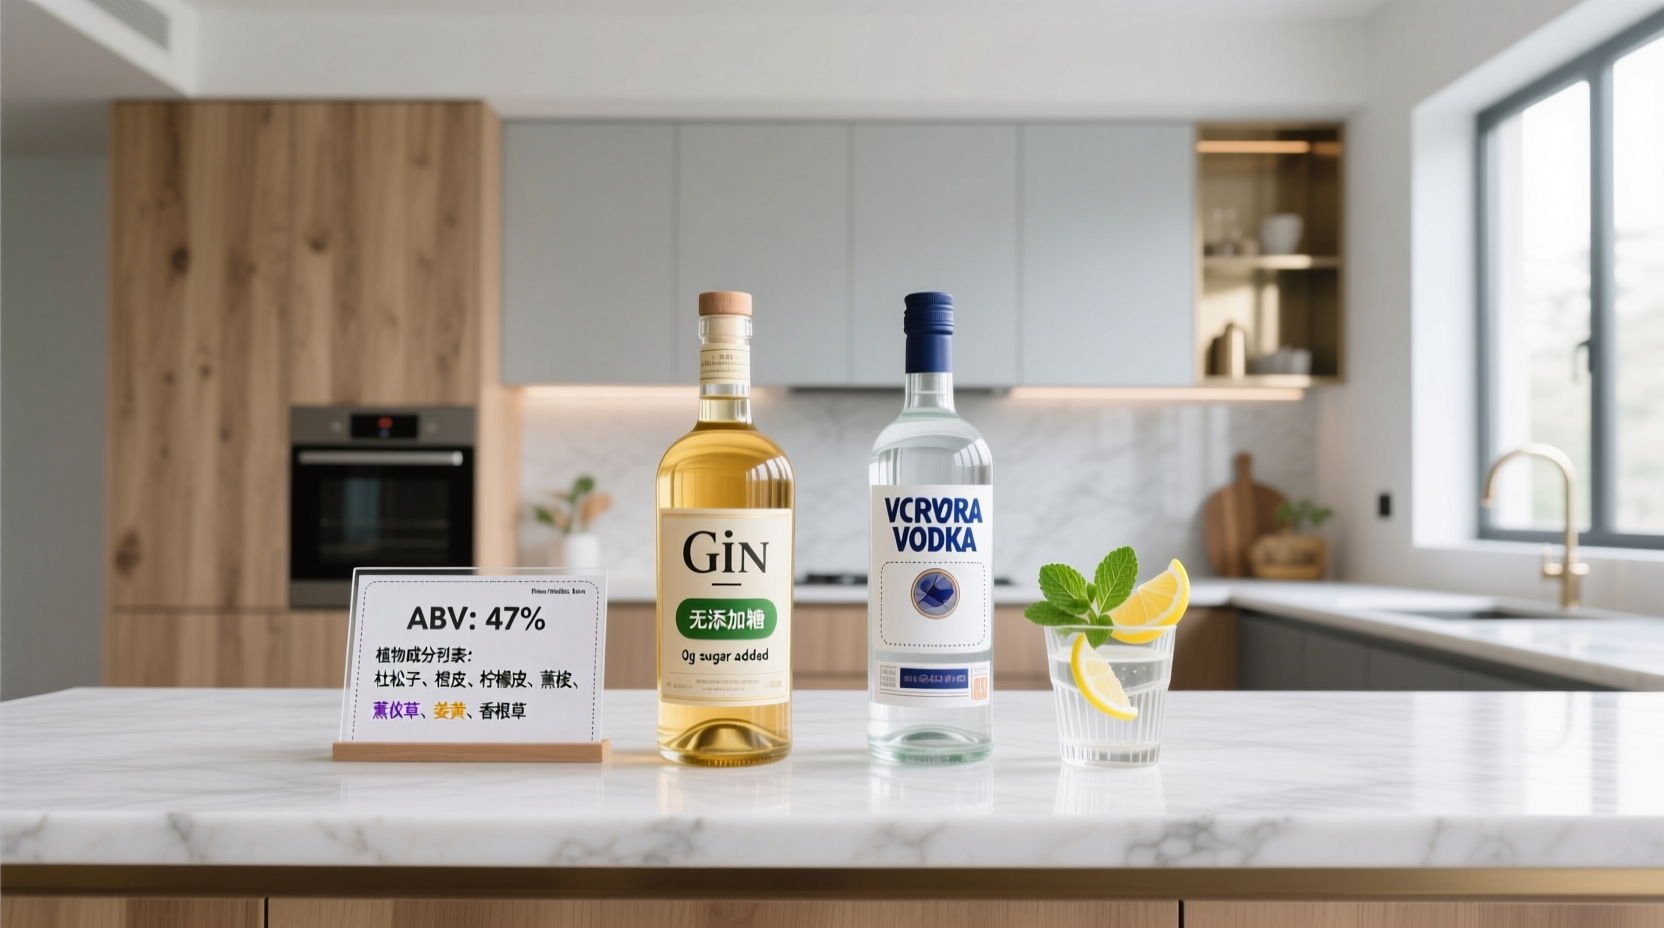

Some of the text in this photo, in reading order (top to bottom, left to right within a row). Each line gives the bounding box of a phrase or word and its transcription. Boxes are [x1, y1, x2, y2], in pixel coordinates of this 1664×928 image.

[892, 526, 977, 552] VODKA
[407, 606, 546, 631] ABV: 47%
[734, 648, 769, 661] added
